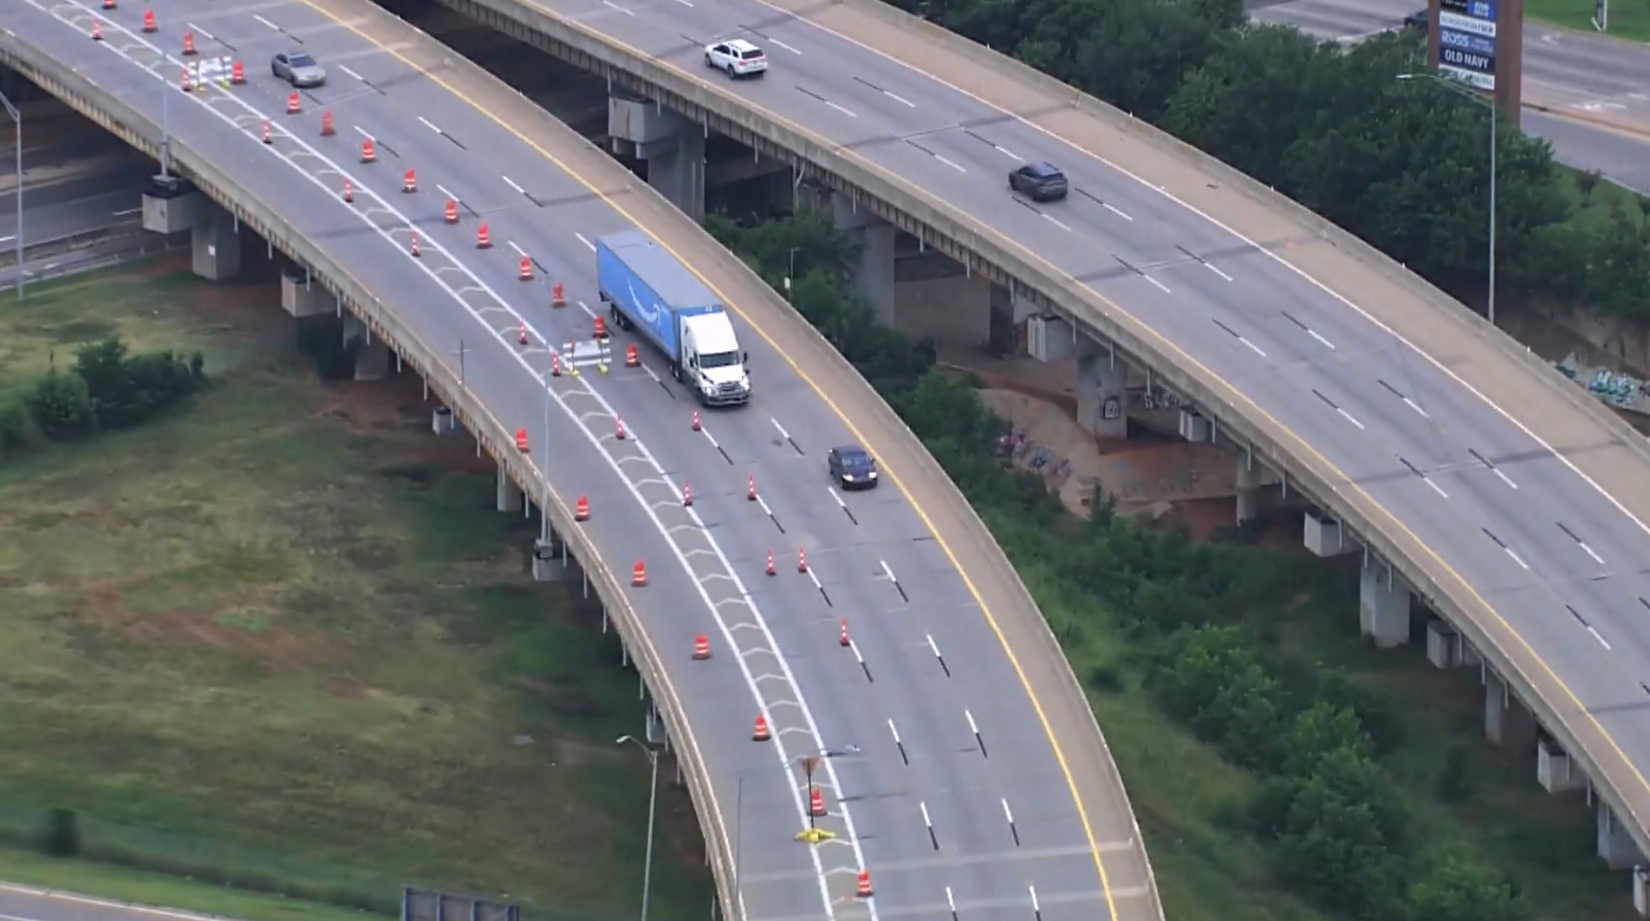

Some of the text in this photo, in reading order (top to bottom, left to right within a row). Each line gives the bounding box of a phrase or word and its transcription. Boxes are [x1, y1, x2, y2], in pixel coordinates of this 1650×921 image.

[1442, 31, 1469, 47] ROSS
[1445, 49, 1489, 69] OLD NAVY
